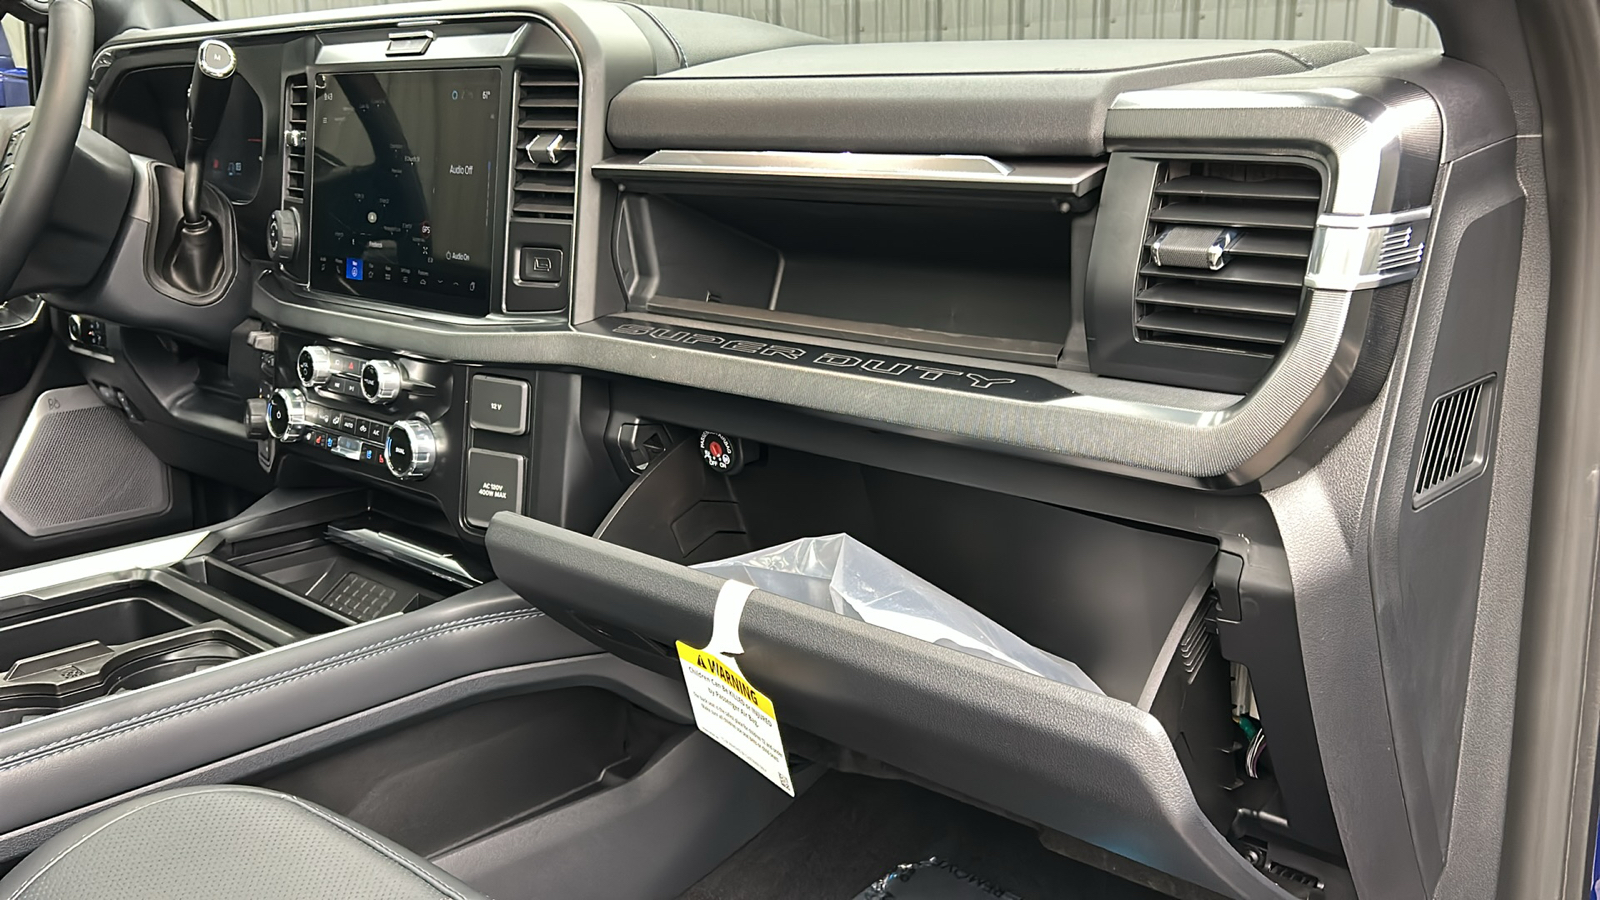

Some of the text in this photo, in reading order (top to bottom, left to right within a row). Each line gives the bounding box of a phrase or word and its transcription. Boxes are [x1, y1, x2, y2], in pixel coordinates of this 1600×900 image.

[450, 164, 473, 176] Audio Off
[422, 225, 430, 234] GPS
[464, 253, 470, 261] On
[612, 323, 1016, 389] SUPER DUTY
[491, 402, 497, 410] 12
[491, 483, 503, 491] 120V
[478, 489, 507, 499] 400W MAX
[689, 667, 710, 683] Children
[711, 678, 721, 689] Can
[708, 658, 758, 706] WARNING
[715, 692, 740, 712] Passenger
